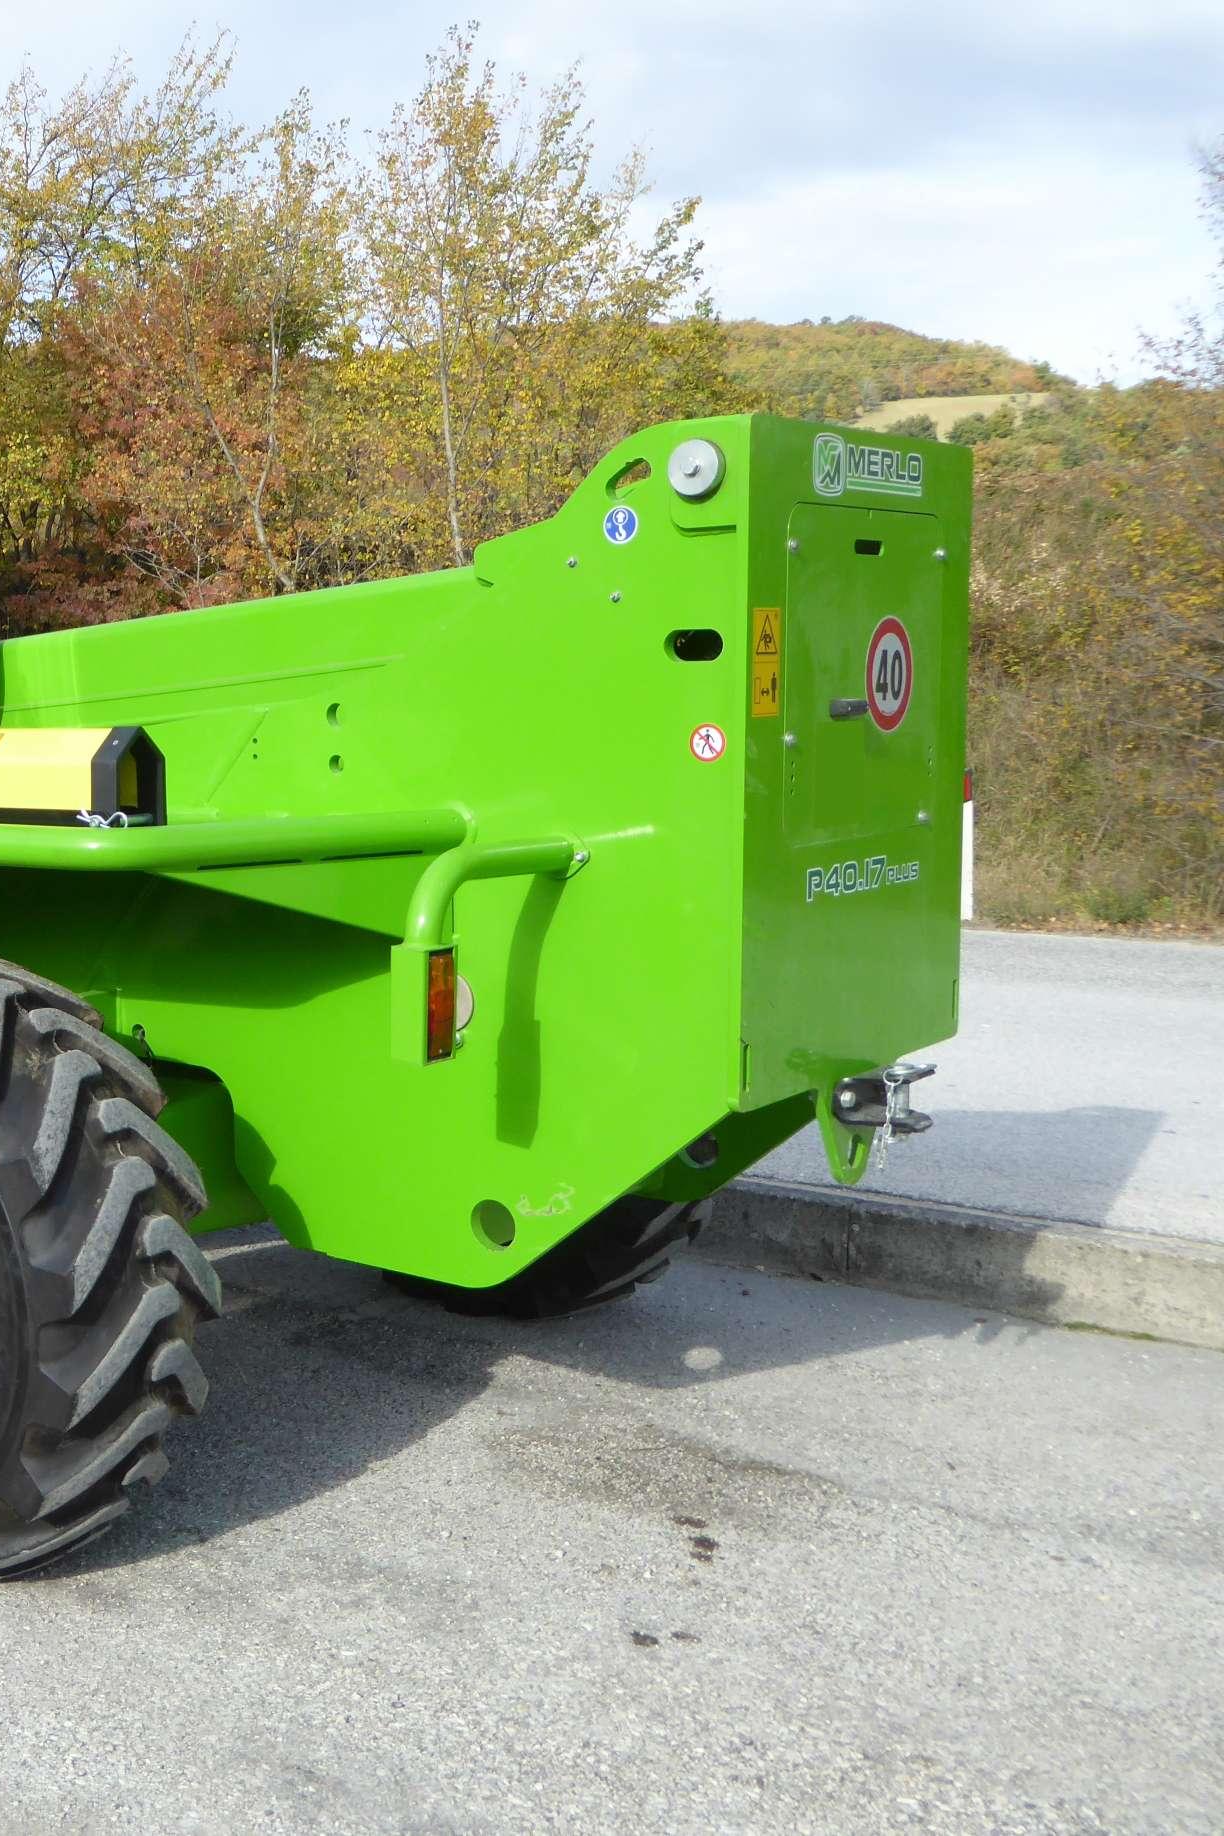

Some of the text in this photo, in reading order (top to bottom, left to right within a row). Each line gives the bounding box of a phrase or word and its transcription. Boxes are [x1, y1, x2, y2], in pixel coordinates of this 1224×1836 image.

[846, 444, 923, 485] MERLO
[875, 649, 903, 701] 40
[806, 855, 919, 902] P40.17 PLUS
